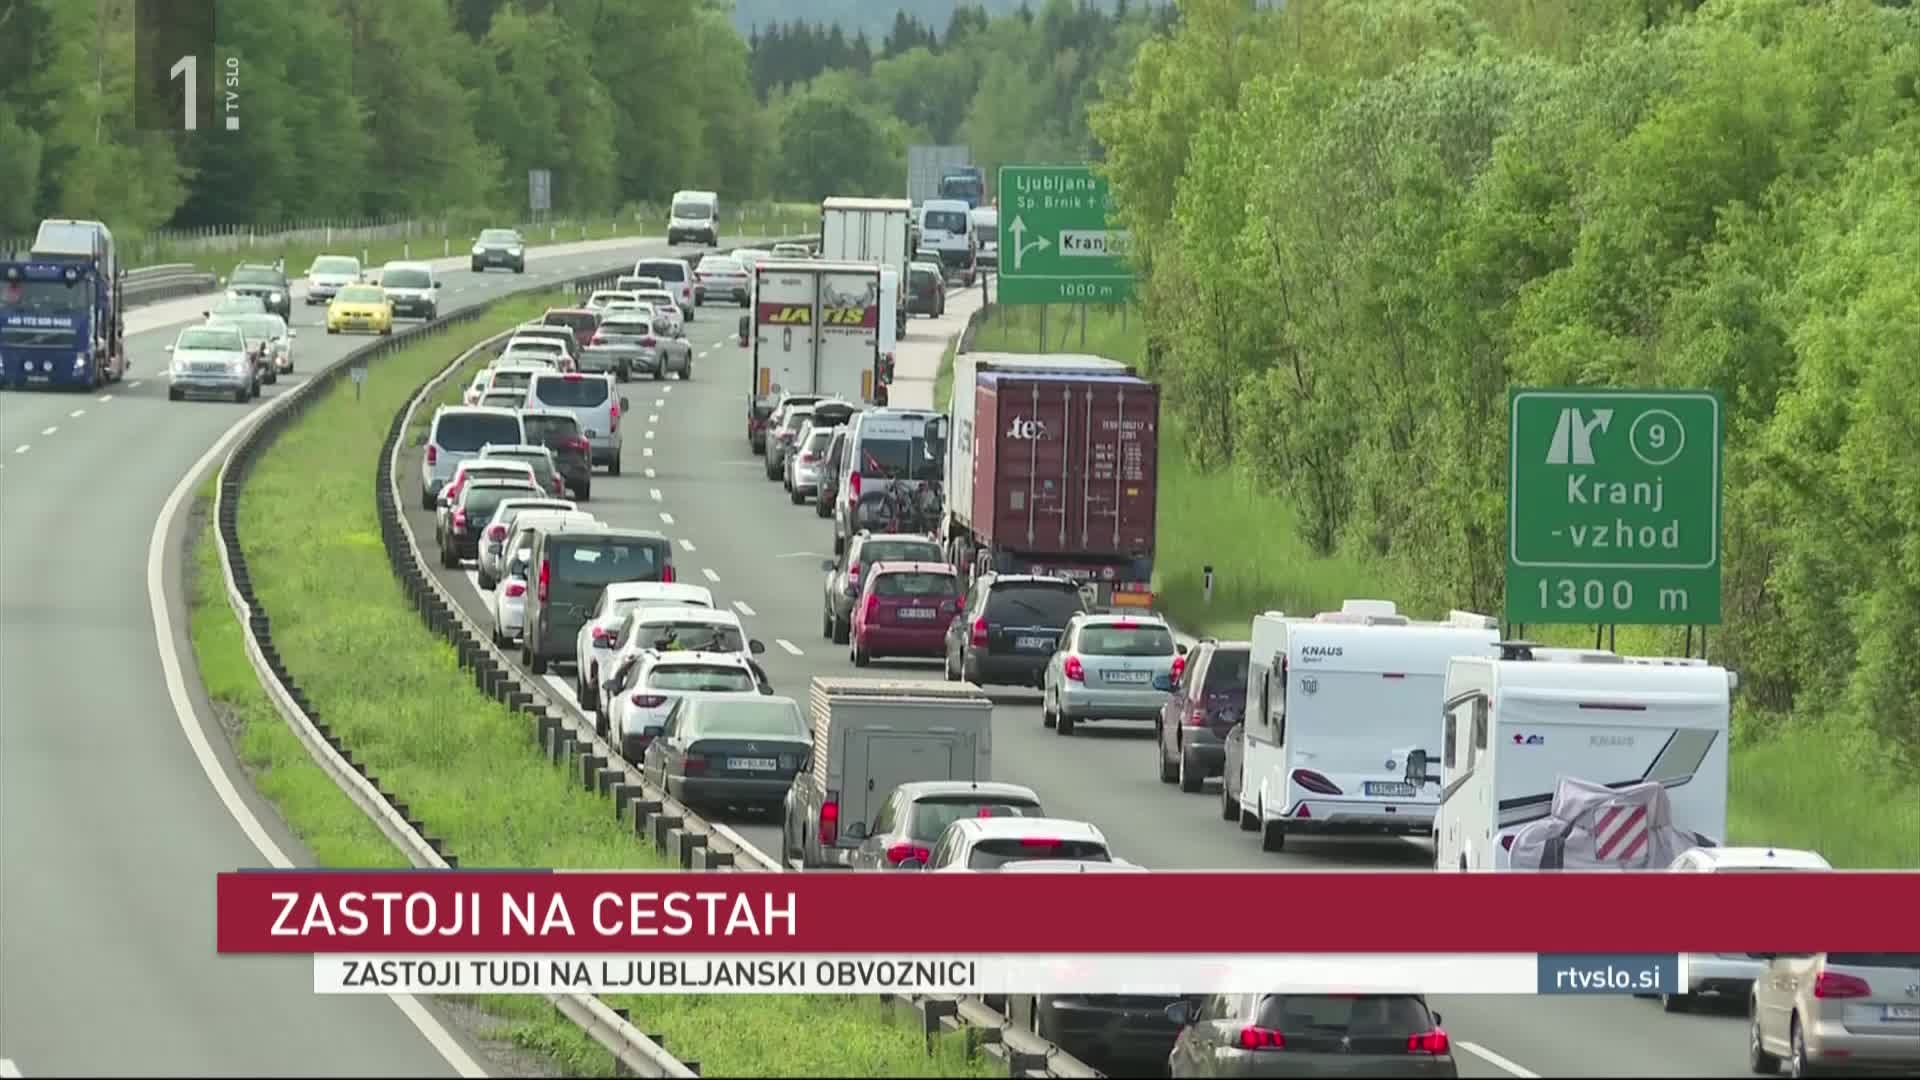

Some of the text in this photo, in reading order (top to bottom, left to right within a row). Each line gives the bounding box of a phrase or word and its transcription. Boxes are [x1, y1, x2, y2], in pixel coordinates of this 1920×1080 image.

[1016, 175, 1096, 193] Ljubljana
[1017, 196, 1081, 212] Sp. Brnik
[1060, 284, 1113, 297] 1000 m
[1649, 424, 1665, 449] 9
[1567, 474, 1664, 513] Kranj
[1551, 518, 1679, 549] -vzhod
[1538, 578, 1689, 611] 1300 m
[1302, 646, 1343, 656] KNAUS
[1589, 735, 1635, 746] KNAUS
